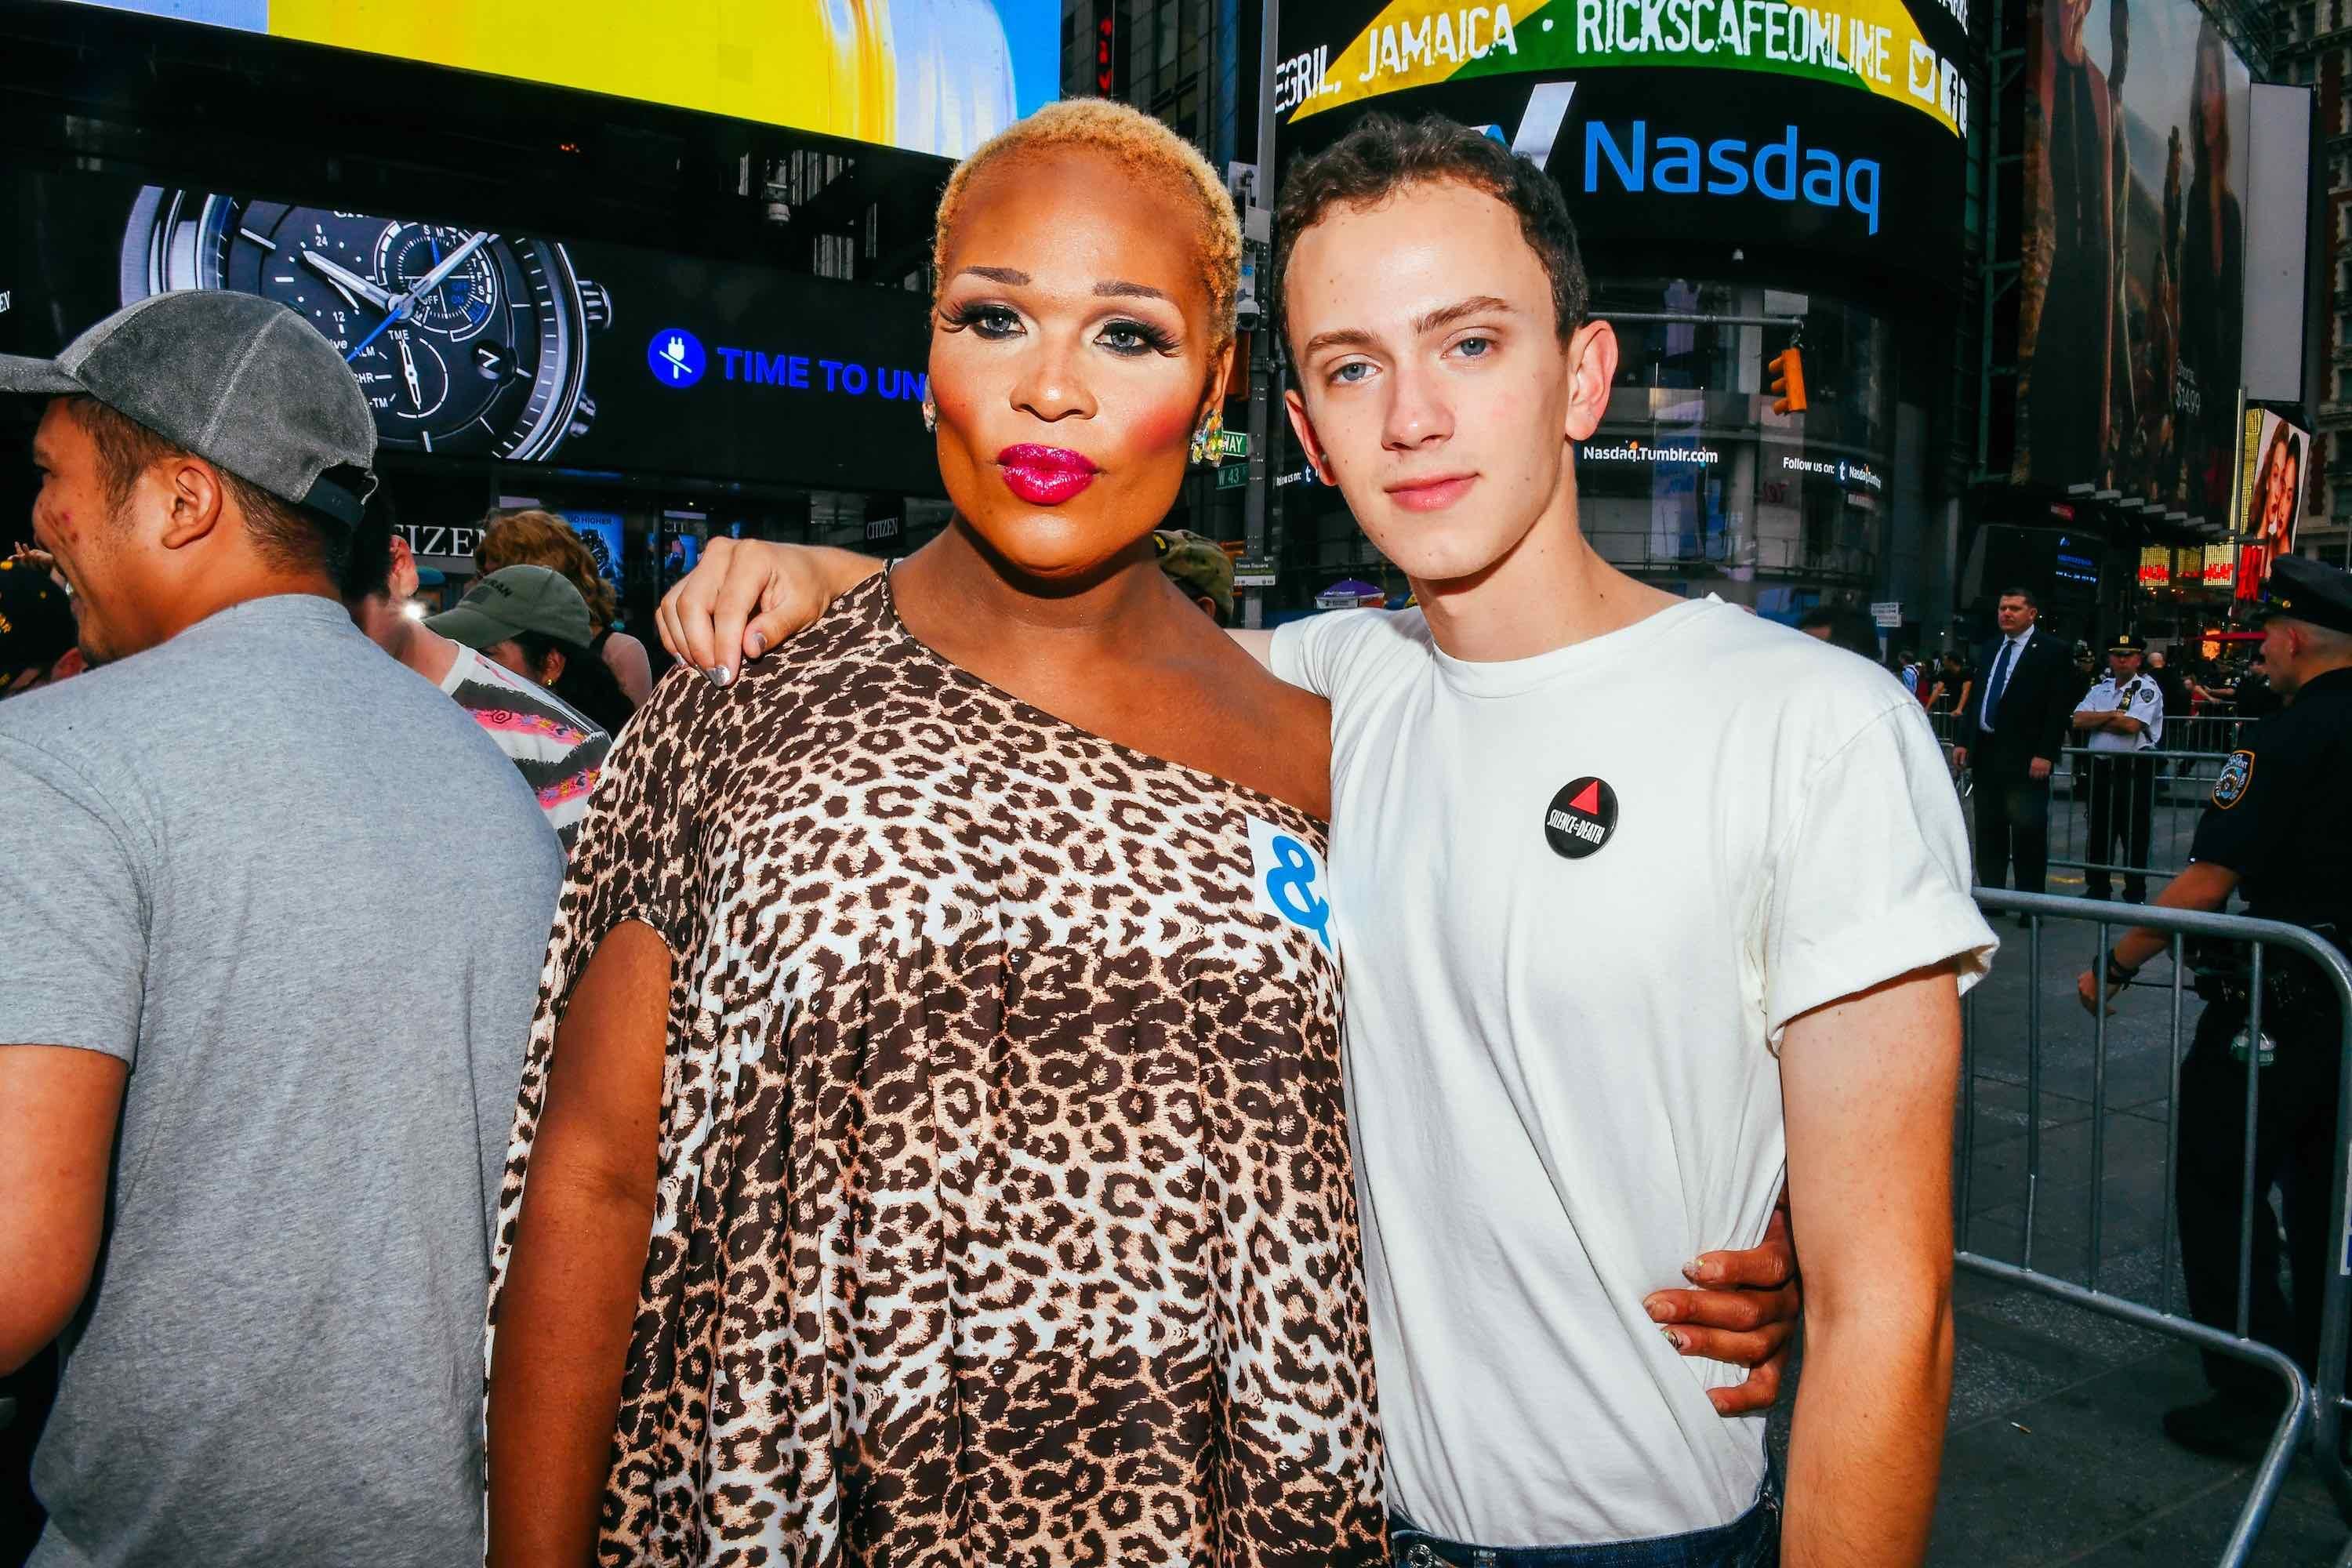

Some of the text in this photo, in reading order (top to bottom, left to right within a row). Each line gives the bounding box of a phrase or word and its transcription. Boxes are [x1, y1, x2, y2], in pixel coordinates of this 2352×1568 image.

[1359, 3, 1518, 82] JAMAICA
[1577, 0, 1892, 84] RICKSCAFEONLINE
[1584, 120, 1880, 235] Nasdaq
[315, 235, 328, 246] 24
[332, 310, 346, 322] 12
[717, 347, 809, 389] TIME
[819, 360, 869, 395] TO
[1584, 446, 1719, 463] Nasdaq.Tumblr.com
[1783, 456, 1812, 471] Follow
[1813, 461, 1823, 473] us
[1824, 464, 1835, 475] on:
[1547, 808, 1606, 845] SILENCE=DEATH
